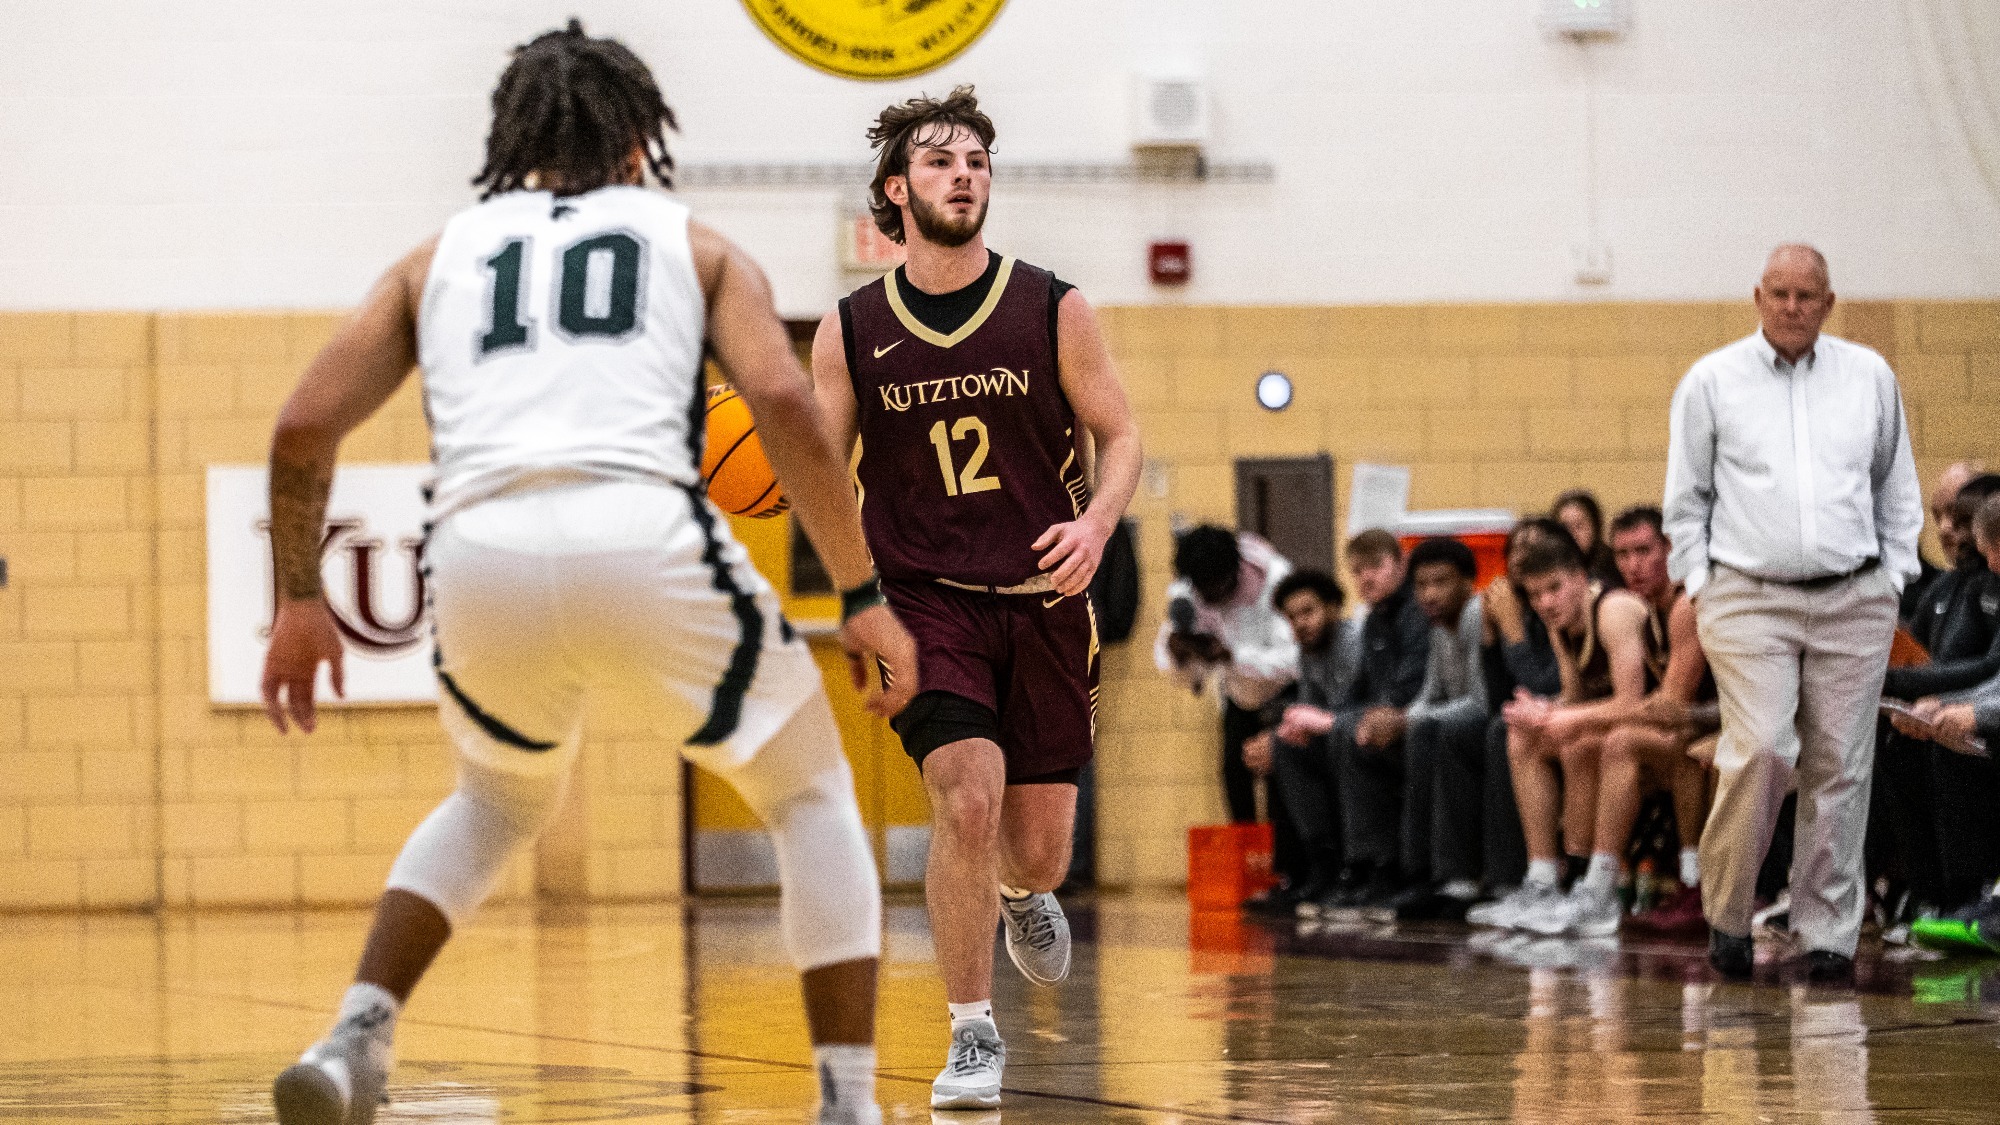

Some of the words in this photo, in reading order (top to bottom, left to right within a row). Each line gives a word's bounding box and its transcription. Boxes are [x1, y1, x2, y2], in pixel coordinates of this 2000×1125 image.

[473, 226, 648, 365] 10
[878, 366, 1030, 412] KUTZTOWN
[928, 415, 1002, 497] 12
